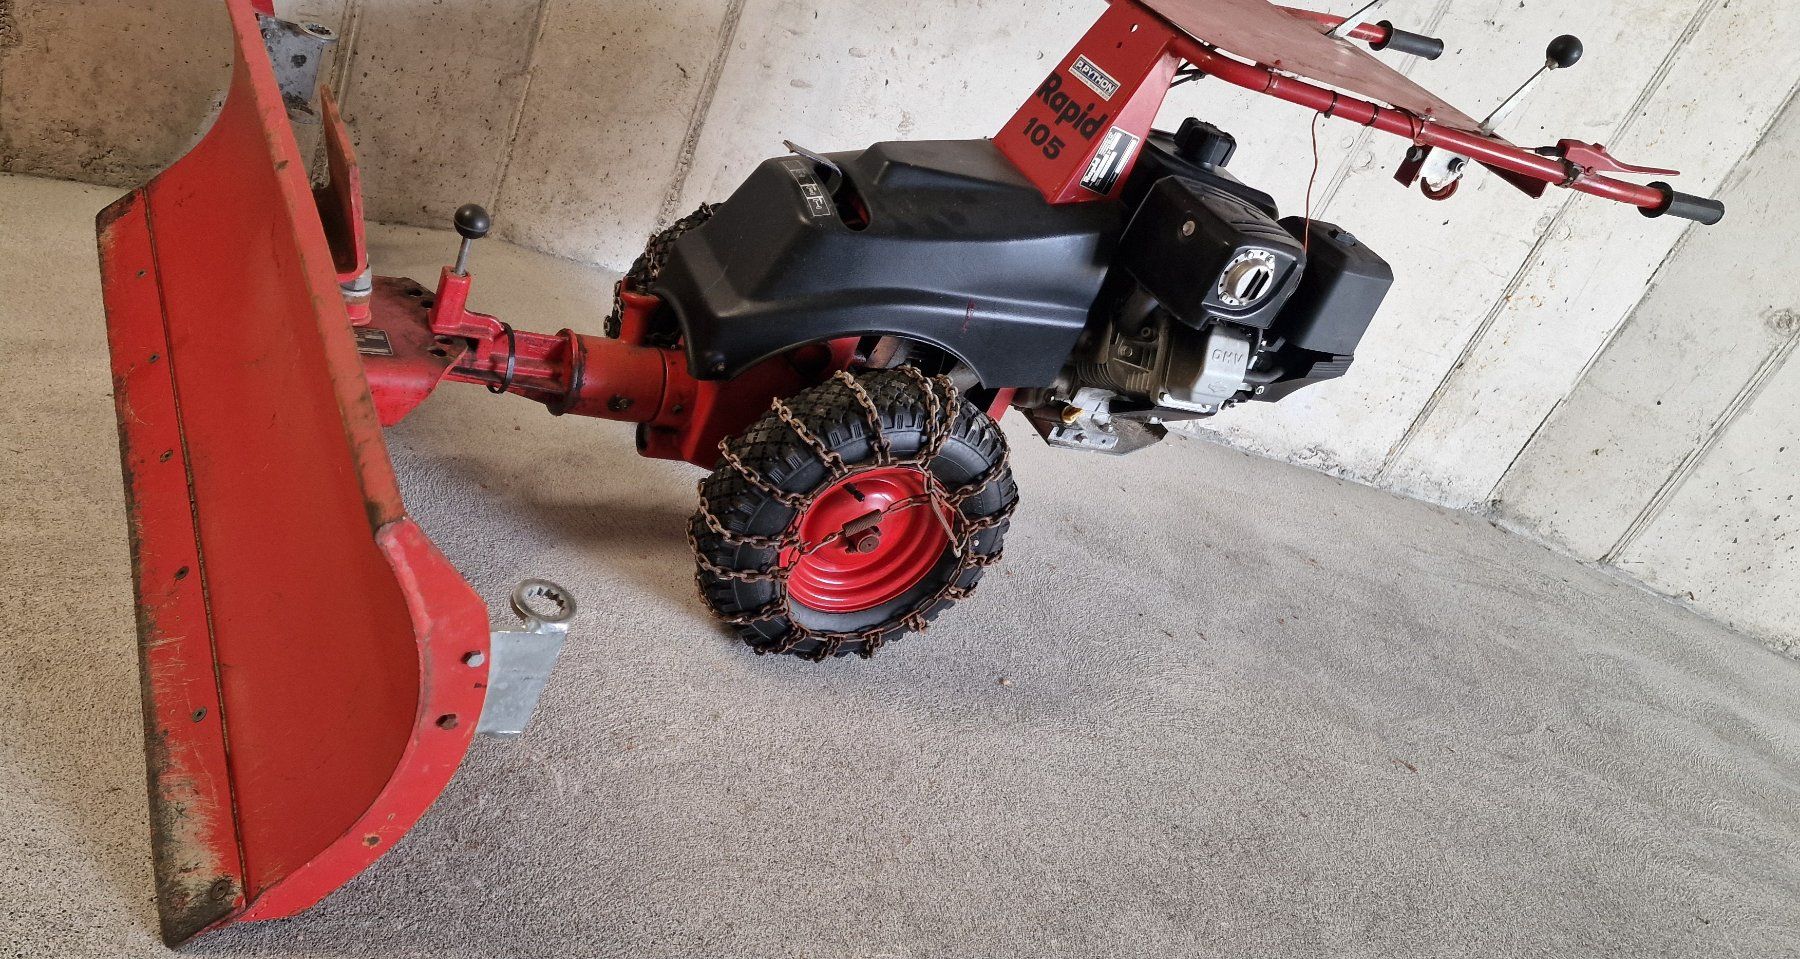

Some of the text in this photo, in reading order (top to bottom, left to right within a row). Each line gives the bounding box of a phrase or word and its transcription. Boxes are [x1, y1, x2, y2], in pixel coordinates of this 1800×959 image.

[1075, 60, 1115, 93] P.PYTHON
[1036, 71, 1109, 141] Rapid
[1023, 117, 1066, 160] 105
